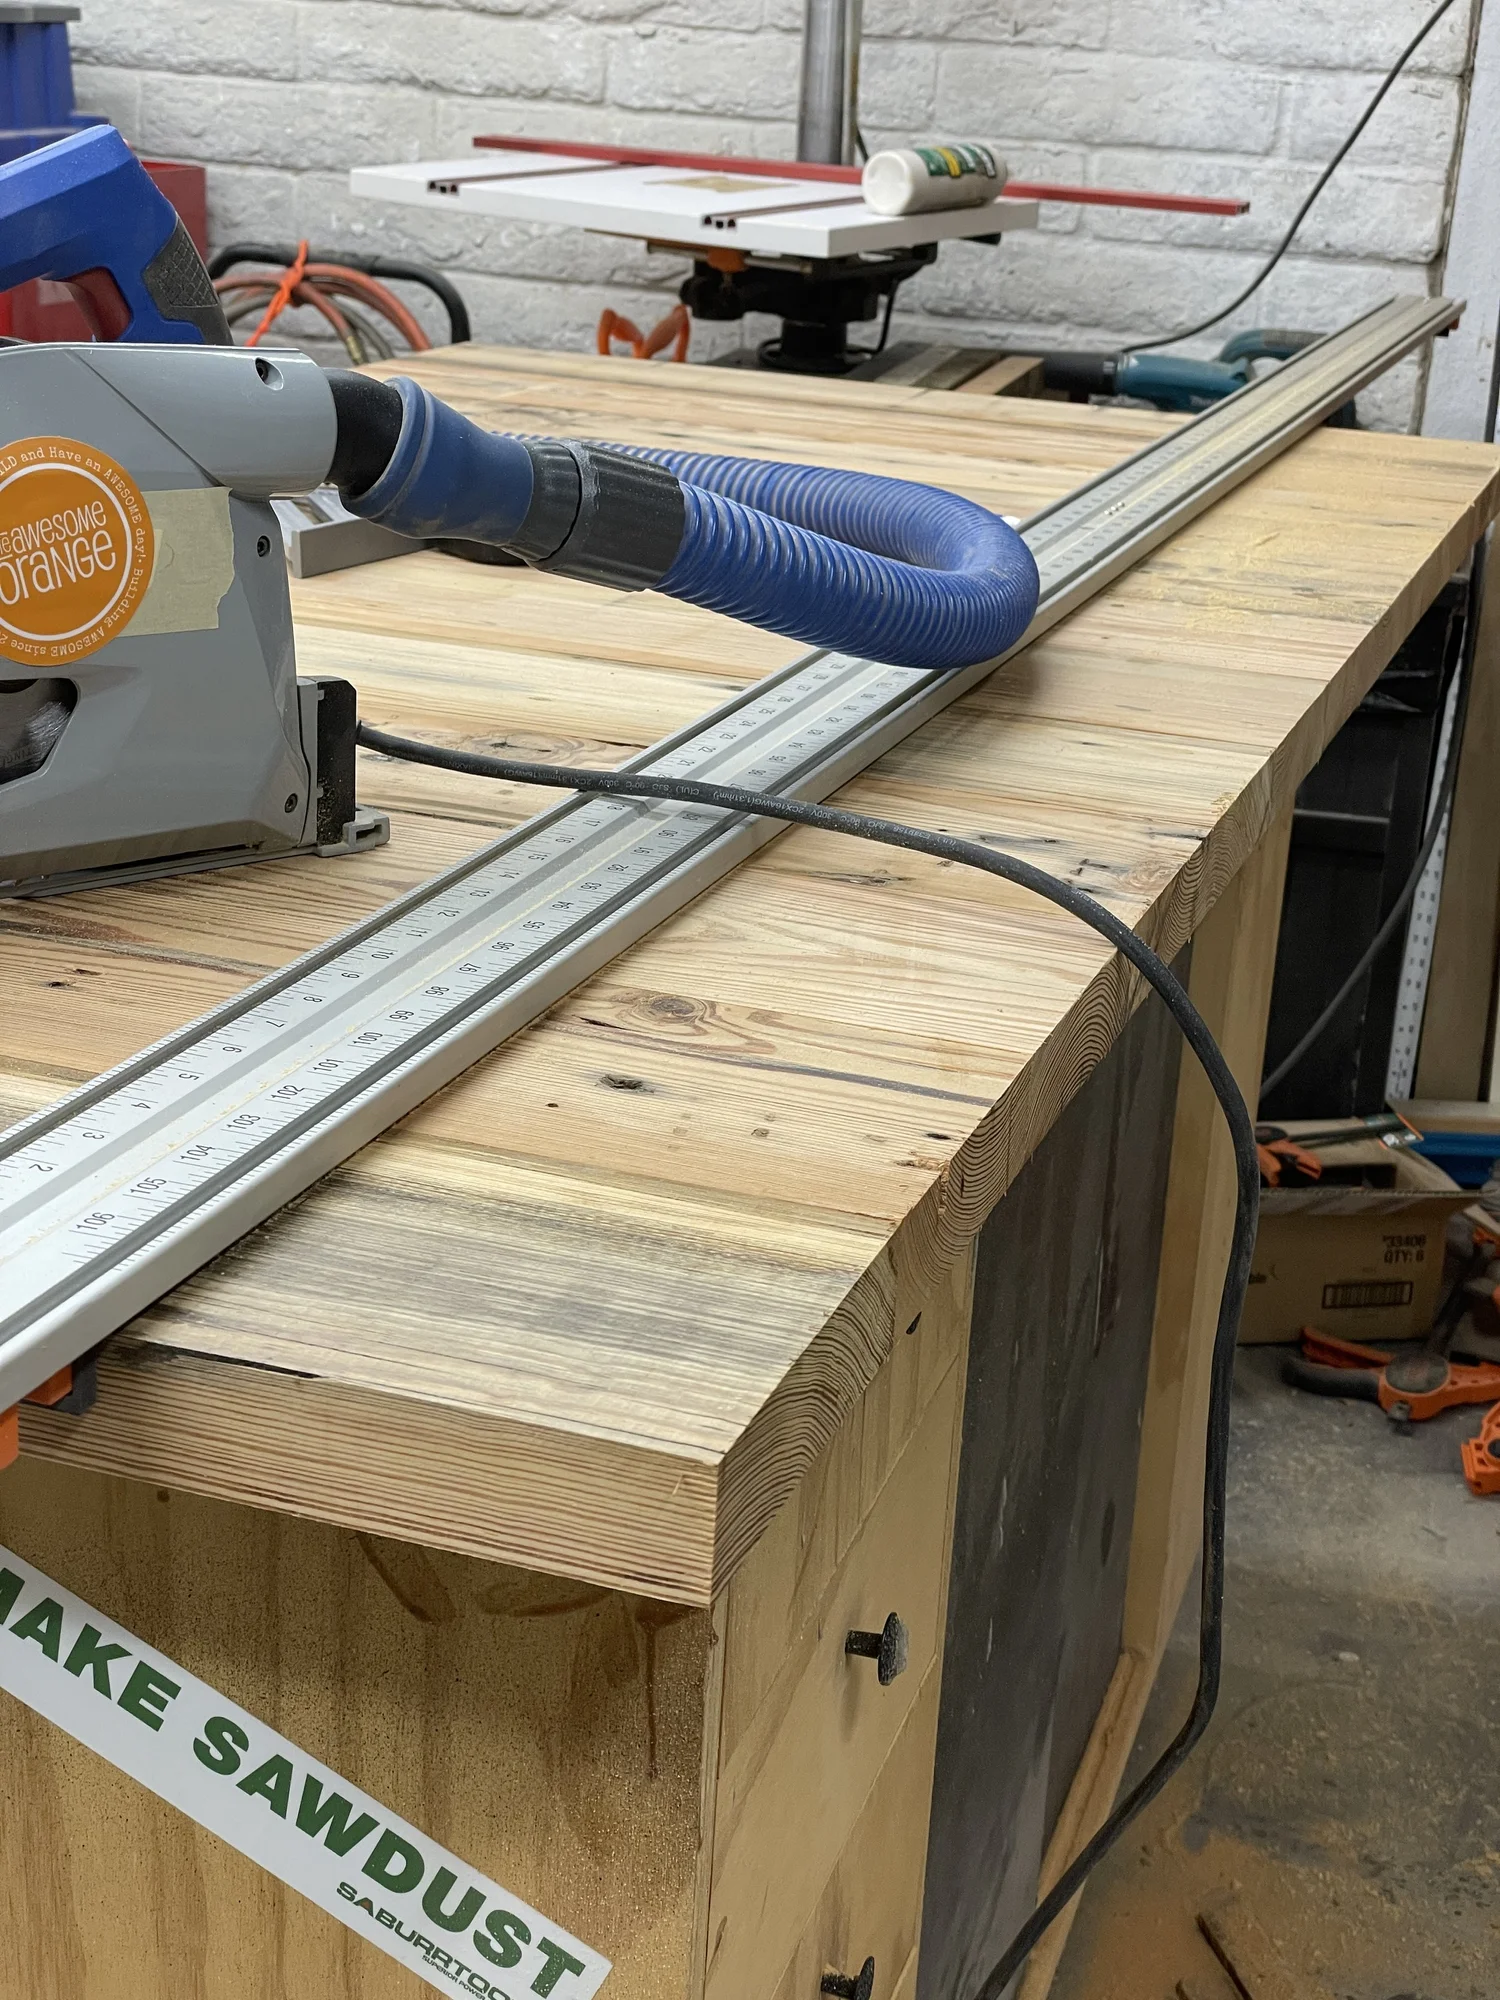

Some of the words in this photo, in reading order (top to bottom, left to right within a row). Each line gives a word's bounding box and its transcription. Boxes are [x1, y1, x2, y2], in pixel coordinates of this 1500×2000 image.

[20, 446, 45, 463] and
[49, 446, 82, 463] Have
[85, 458, 101, 472] an
[103, 468, 143, 524] AWESOME
[104, 568, 144, 628] Building
[50, 626, 105, 657] AWESOME
[10, 639, 47, 656] since
[810, 809, 834, 820] 300V
[582, 819, 601, 827] 17
[555, 836, 576, 844] 16
[528, 853, 549, 861] 15
[499, 871, 521, 879] 14
[469, 889, 491, 898] 13
[437, 909, 461, 918] 12
[405, 929, 428, 938] 11
[371, 950, 394, 960] 10
[303, 995, 323, 1003] 8
[265, 1019, 285, 1029] 7
[76, 1212, 115, 1230] 106
[130, 1177, 167, 1195] 105
[180, 1144, 216, 1161] 104
[227, 1114, 261, 1131] 103
[271, 1084, 305, 1100] 102
[312, 1057, 345, 1073] 101
[352, 1031, 383, 1045] 100
[389, 1010, 415, 1021] 99
[425, 985, 450, 996] 98
[459, 963, 482, 973] 97
[491, 941, 515, 951] 96
[522, 920, 546, 930] 95
[552, 900, 574, 910] 94
[580, 881, 602, 891] 93
[607, 863, 629, 872] 92
[633, 846, 654, 855] 91
[658, 829, 678, 838] 90
[222, 1045, 242, 1054] 6
[178, 1073, 200, 1081] 5
[130, 1102, 151, 1110] 4
[82, 1131, 105, 1140] 3
[28, 1163, 54, 1172] 2
[193, 1716, 586, 2000] SAWDUST
[336, 1881, 524, 2000] SABURRTOO
[421, 1954, 459, 1983] SUPERIOR
